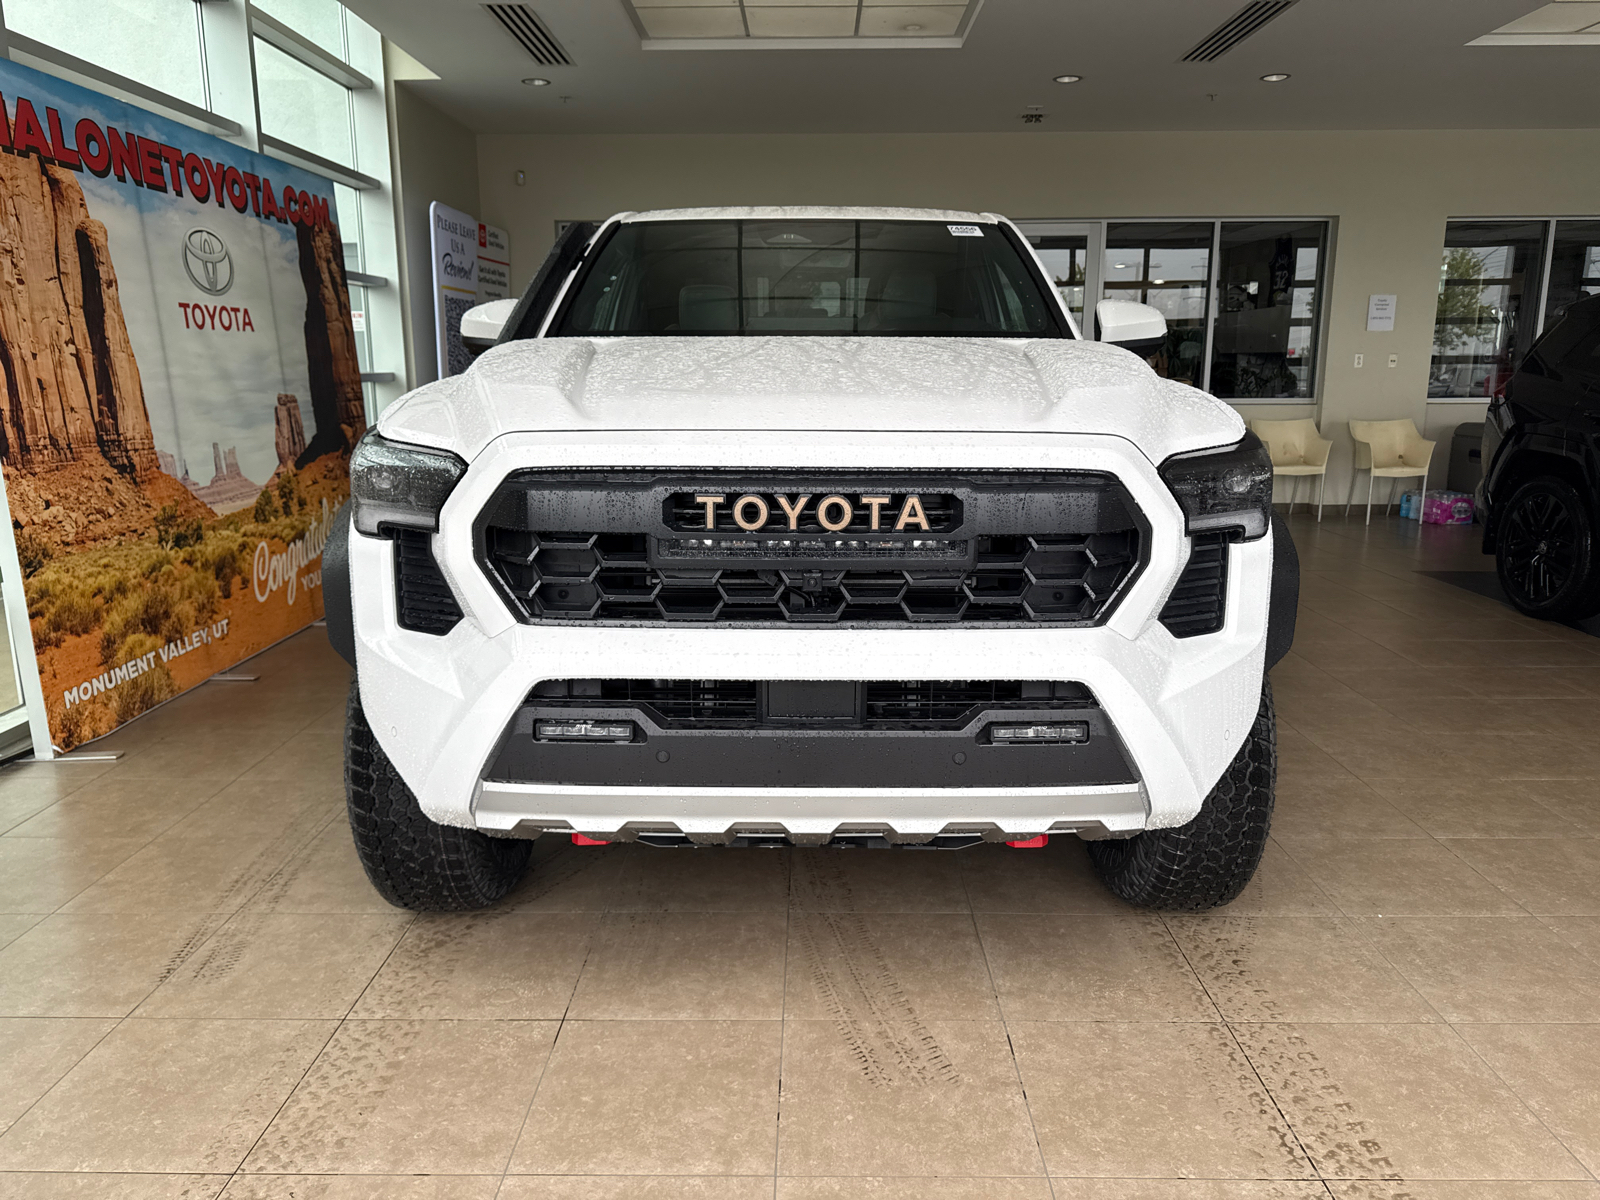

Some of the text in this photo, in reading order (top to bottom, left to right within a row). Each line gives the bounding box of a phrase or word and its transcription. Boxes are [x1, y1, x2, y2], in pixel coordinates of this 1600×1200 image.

[437, 214, 476, 241] PLEASE LEAVE
[1273, 270, 1289, 290] 32
[179, 302, 254, 333] TOYOTA
[694, 493, 933, 533] TOYOTA
[63, 618, 229, 709] MONUMENT VALLEY, UT
